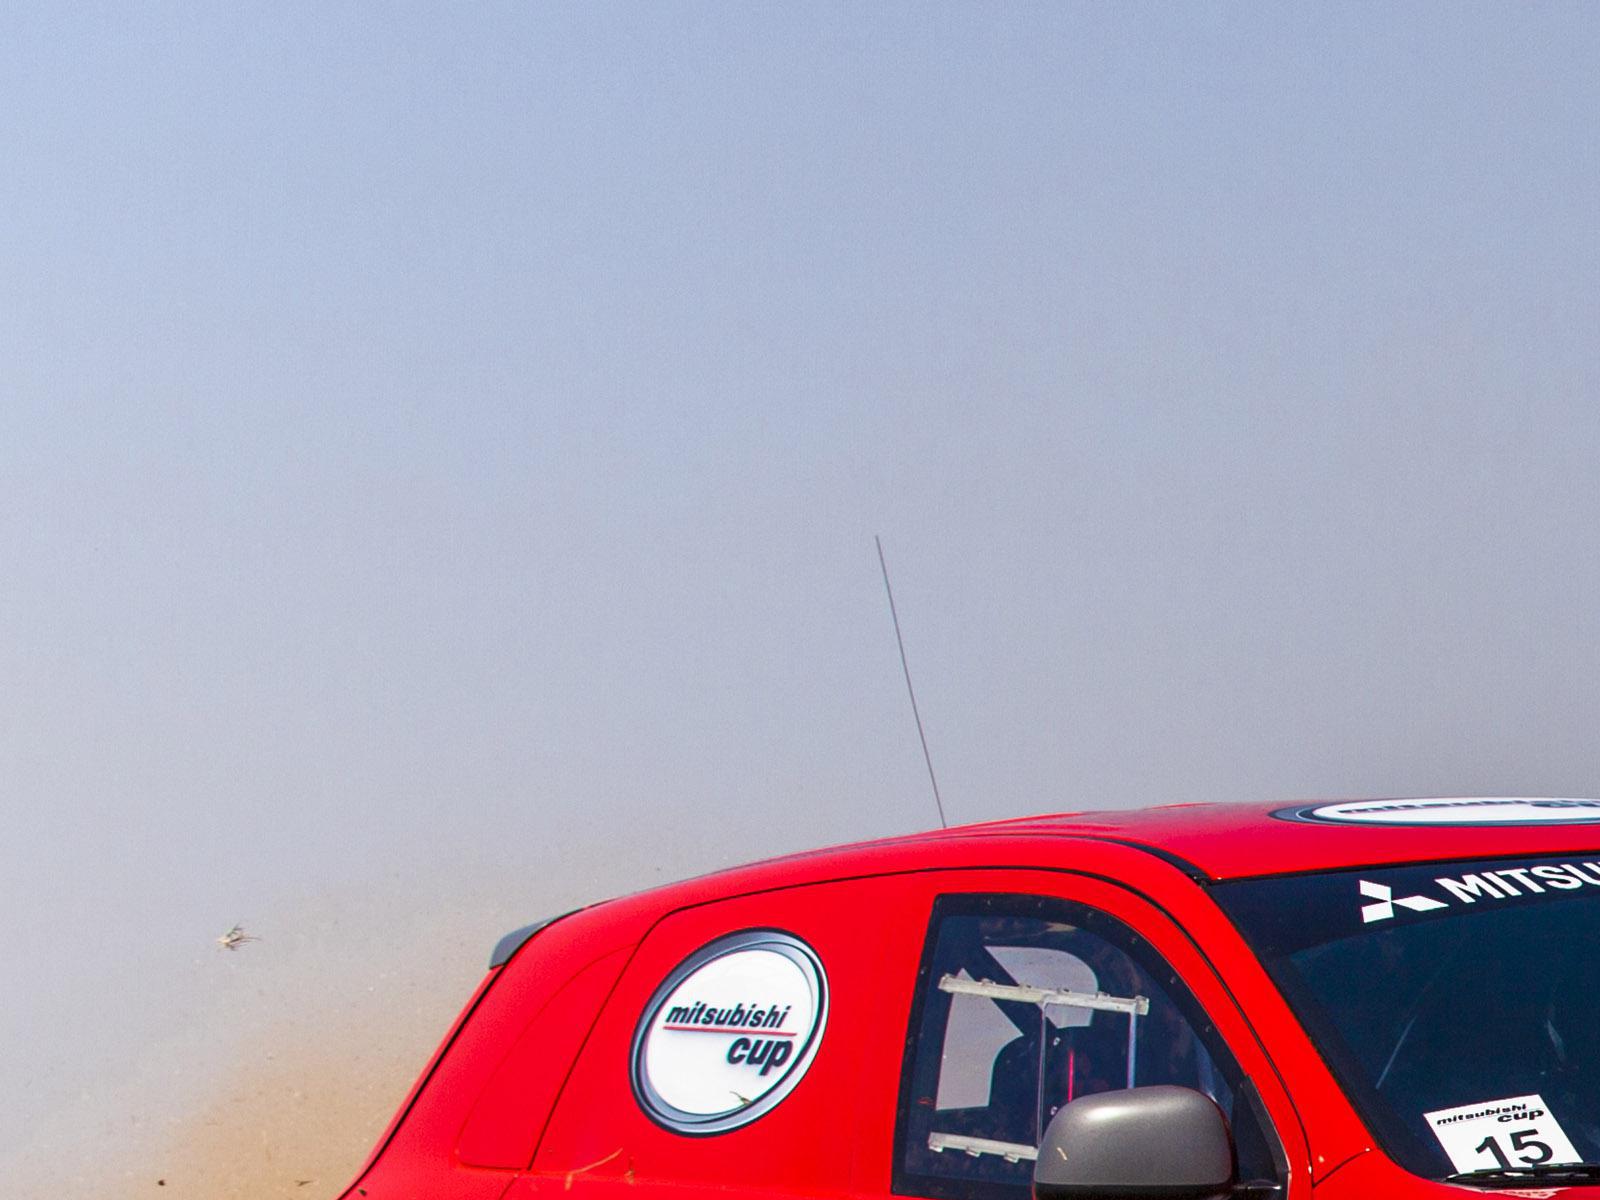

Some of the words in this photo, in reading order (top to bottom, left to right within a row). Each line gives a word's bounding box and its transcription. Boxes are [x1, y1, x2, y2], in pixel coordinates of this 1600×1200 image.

[665, 1001, 792, 1028] mitsubishi
[726, 1037, 794, 1076] cup
[1436, 1103, 1527, 1126] mitsubishi
[1497, 1109, 1545, 1123] cup
[1474, 1128, 1554, 1170] 15
